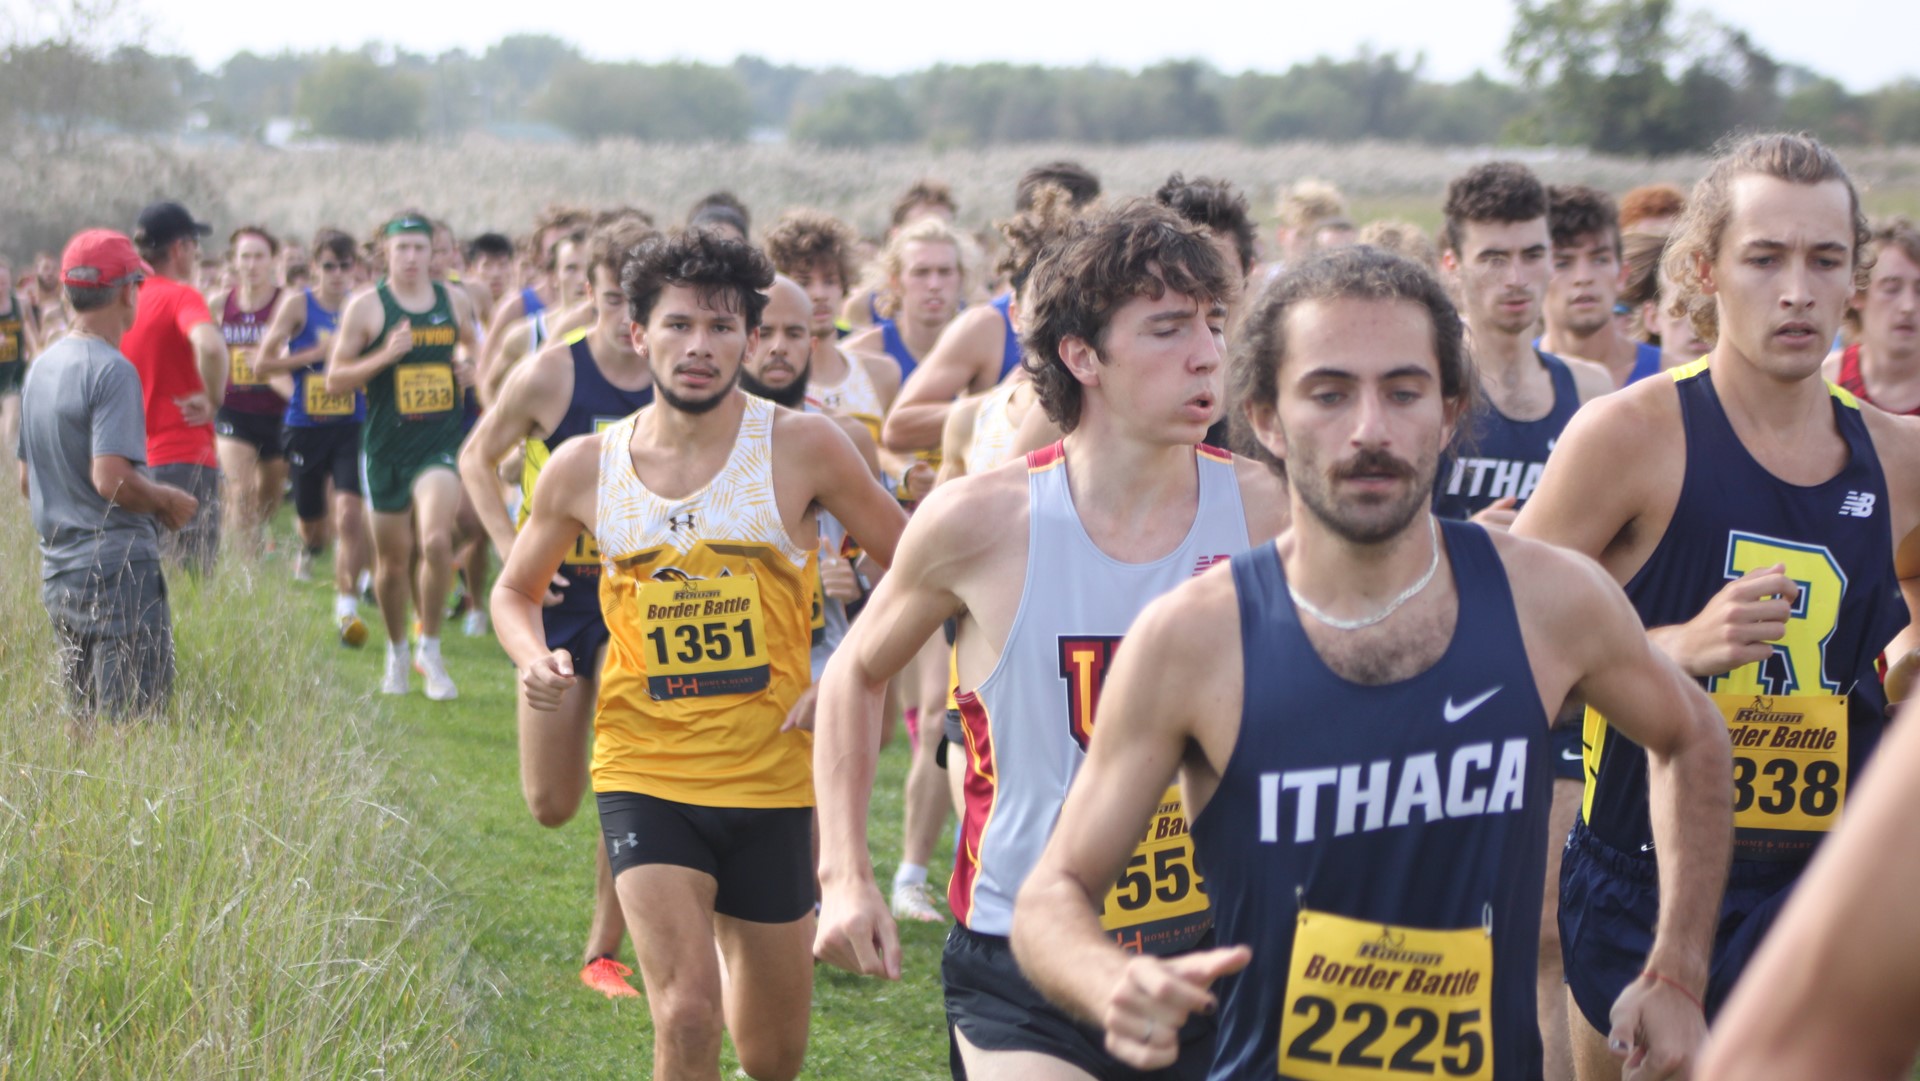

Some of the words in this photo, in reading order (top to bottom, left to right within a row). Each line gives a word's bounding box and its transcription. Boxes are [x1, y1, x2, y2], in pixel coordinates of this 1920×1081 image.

[402, 387, 451, 409] 1233
[1446, 457, 1545, 499] ITHA
[647, 602, 701, 620] Border
[704, 597, 751, 616] Battle
[647, 618, 756, 665] 1351
[1733, 708, 1804, 725] Rowan
[1769, 725, 1837, 750] Battle
[1259, 738, 1529, 844] ITHACA
[1733, 756, 1840, 817] 338
[1304, 954, 1402, 991] Border
[1402, 967, 1479, 997] Battle
[1287, 994, 1484, 1077] 2225
